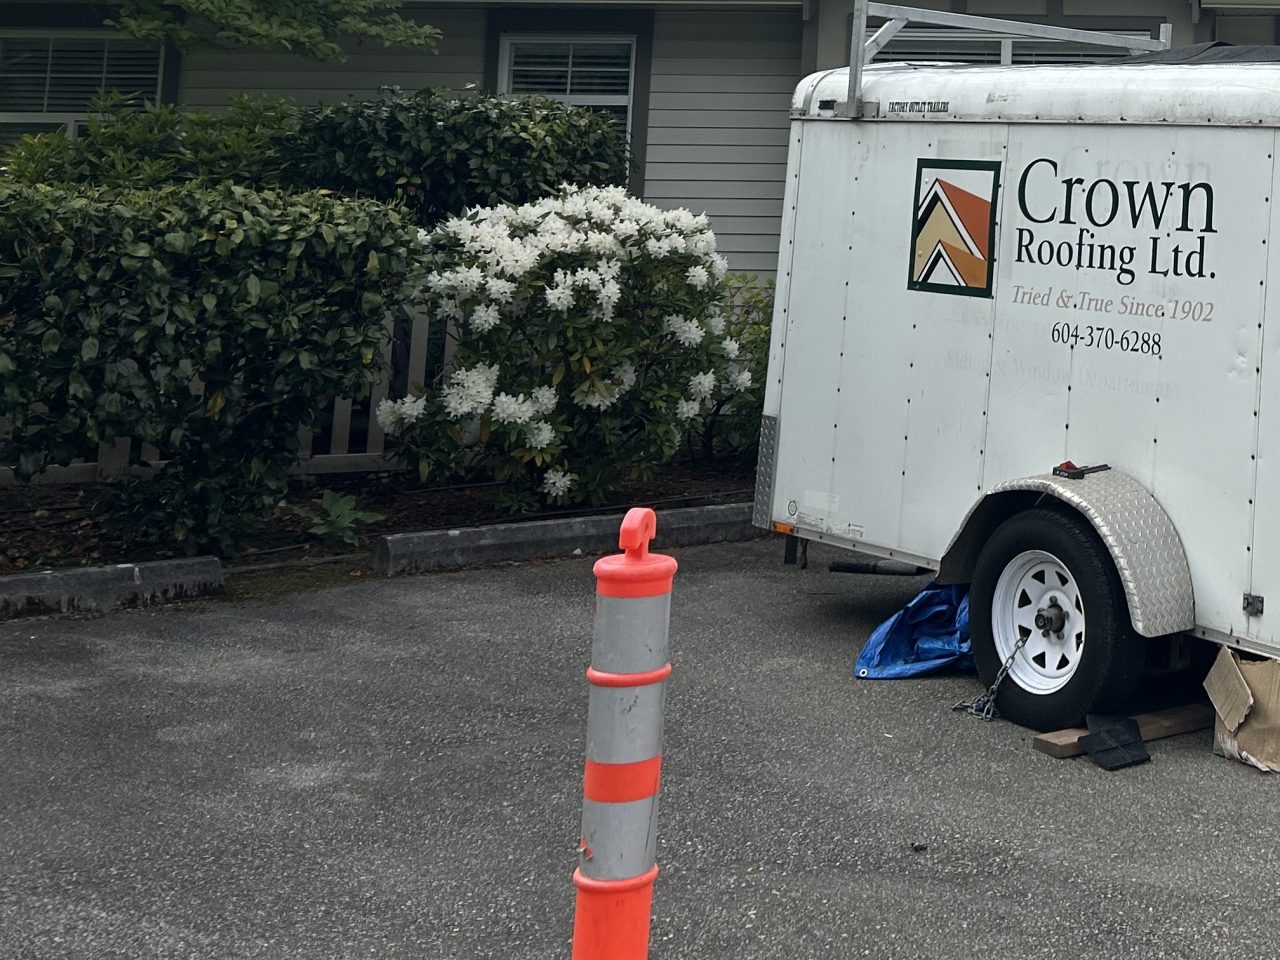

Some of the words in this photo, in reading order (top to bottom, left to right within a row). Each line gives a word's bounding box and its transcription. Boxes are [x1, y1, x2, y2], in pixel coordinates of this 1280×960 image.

[1017, 157, 1218, 234] Crown
[1015, 227, 1137, 286] Roofing
[1148, 235, 1217, 280] Ltd.
[1011, 285, 1053, 307] Tried
[1055, 289, 1074, 309] &
[1077, 291, 1114, 314] True
[1117, 295, 1165, 318] Since
[1169, 299, 1215, 323] 1902
[1051, 321, 1162, 356] 604-370-6288
